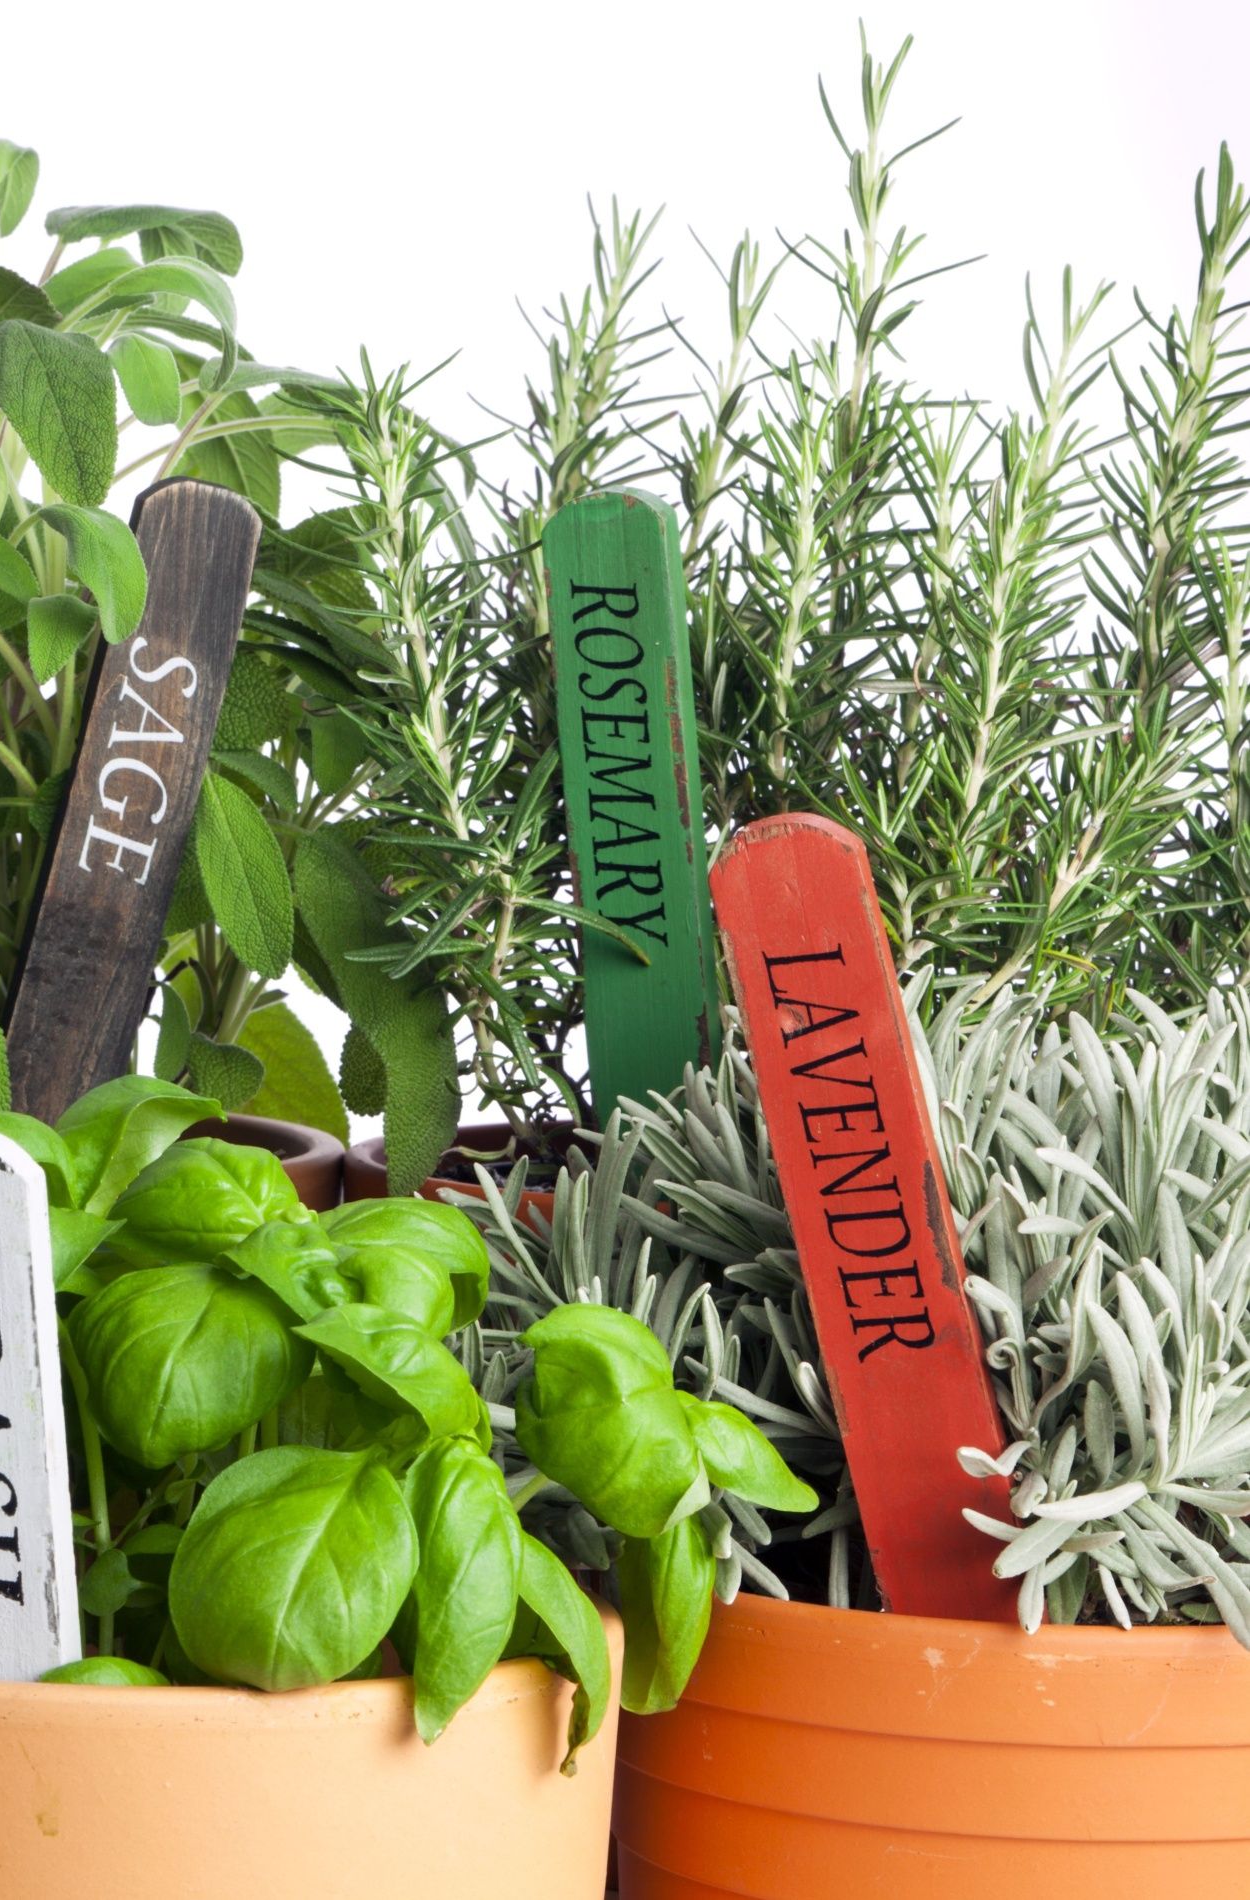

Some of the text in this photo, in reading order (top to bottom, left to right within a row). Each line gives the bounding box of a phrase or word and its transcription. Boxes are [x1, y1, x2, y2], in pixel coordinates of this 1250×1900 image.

[79, 636, 197, 885] SAGE
[569, 579, 668, 947] ROSEMARY
[762, 943, 935, 1364] LAVENDER
